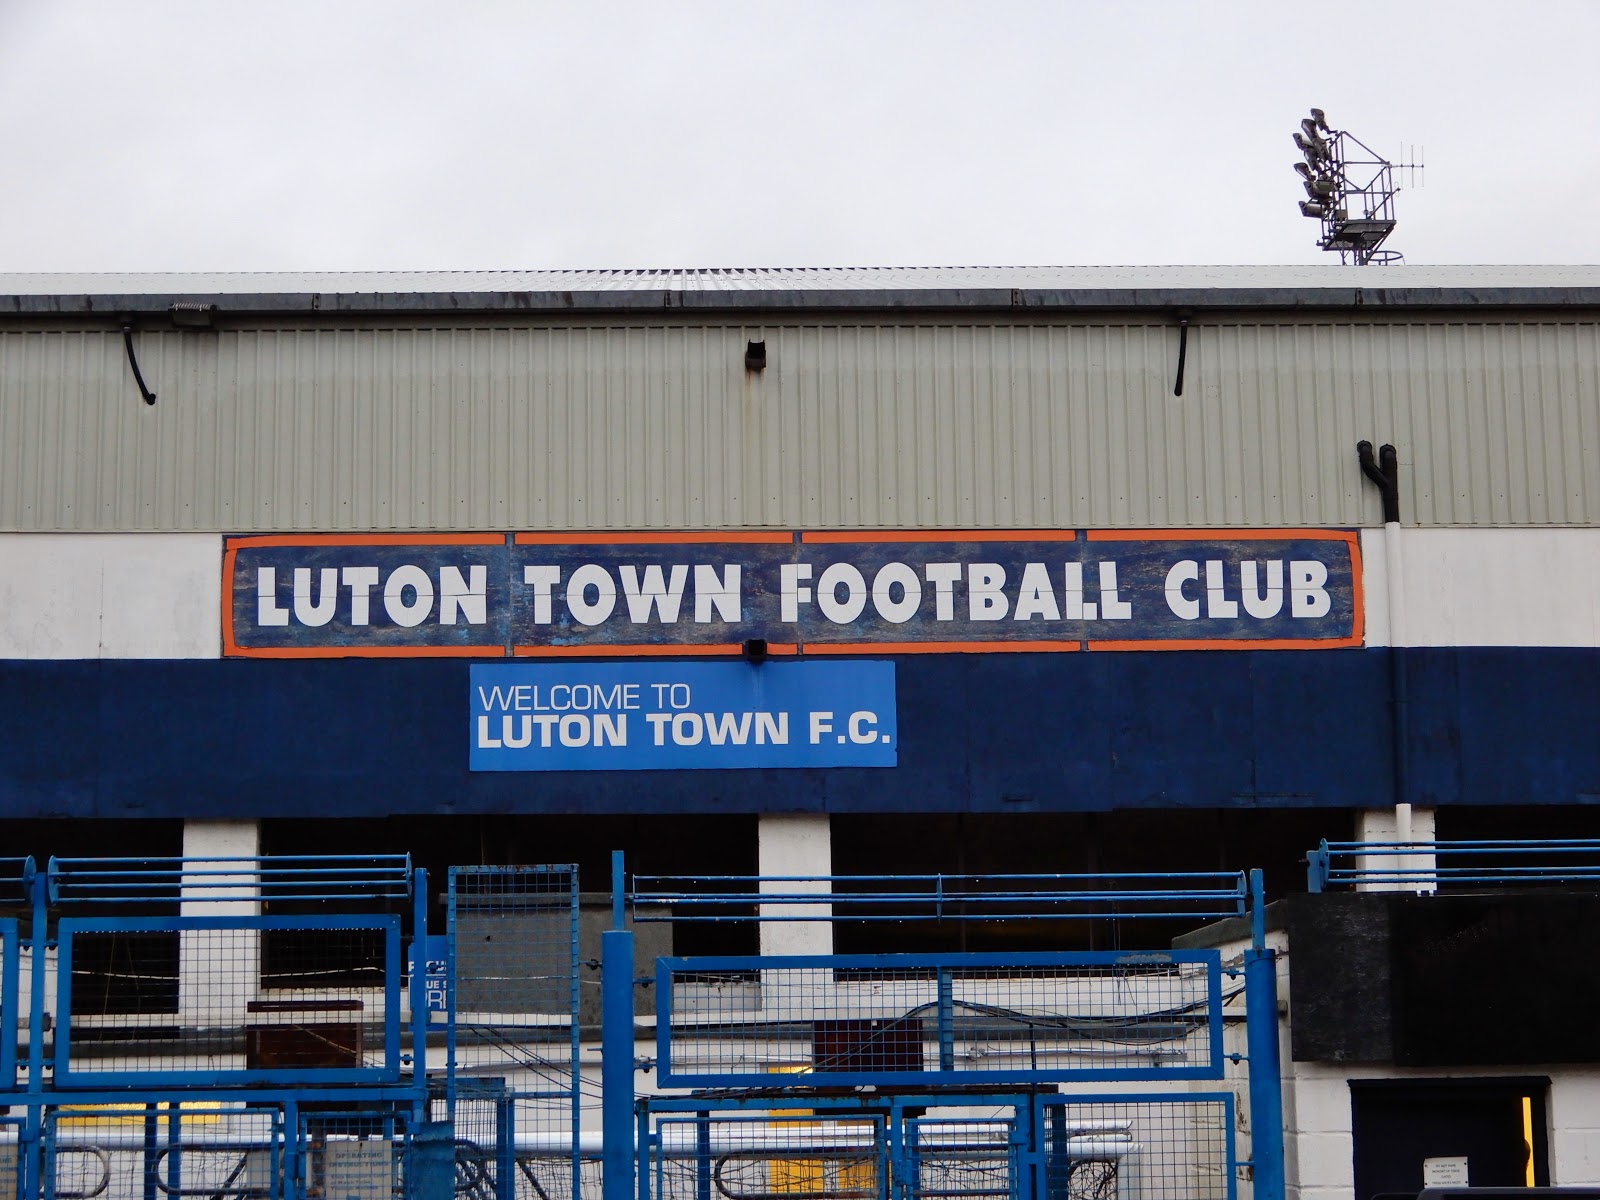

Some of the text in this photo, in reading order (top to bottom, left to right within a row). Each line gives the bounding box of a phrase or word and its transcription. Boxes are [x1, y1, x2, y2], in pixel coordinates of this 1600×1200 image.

[257, 559, 1331, 629] LUTON TOWN FOOTBALL CLUB
[478, 683, 691, 712] WELCOME TO
[477, 710, 891, 750] LUTON TOWN F.C.
